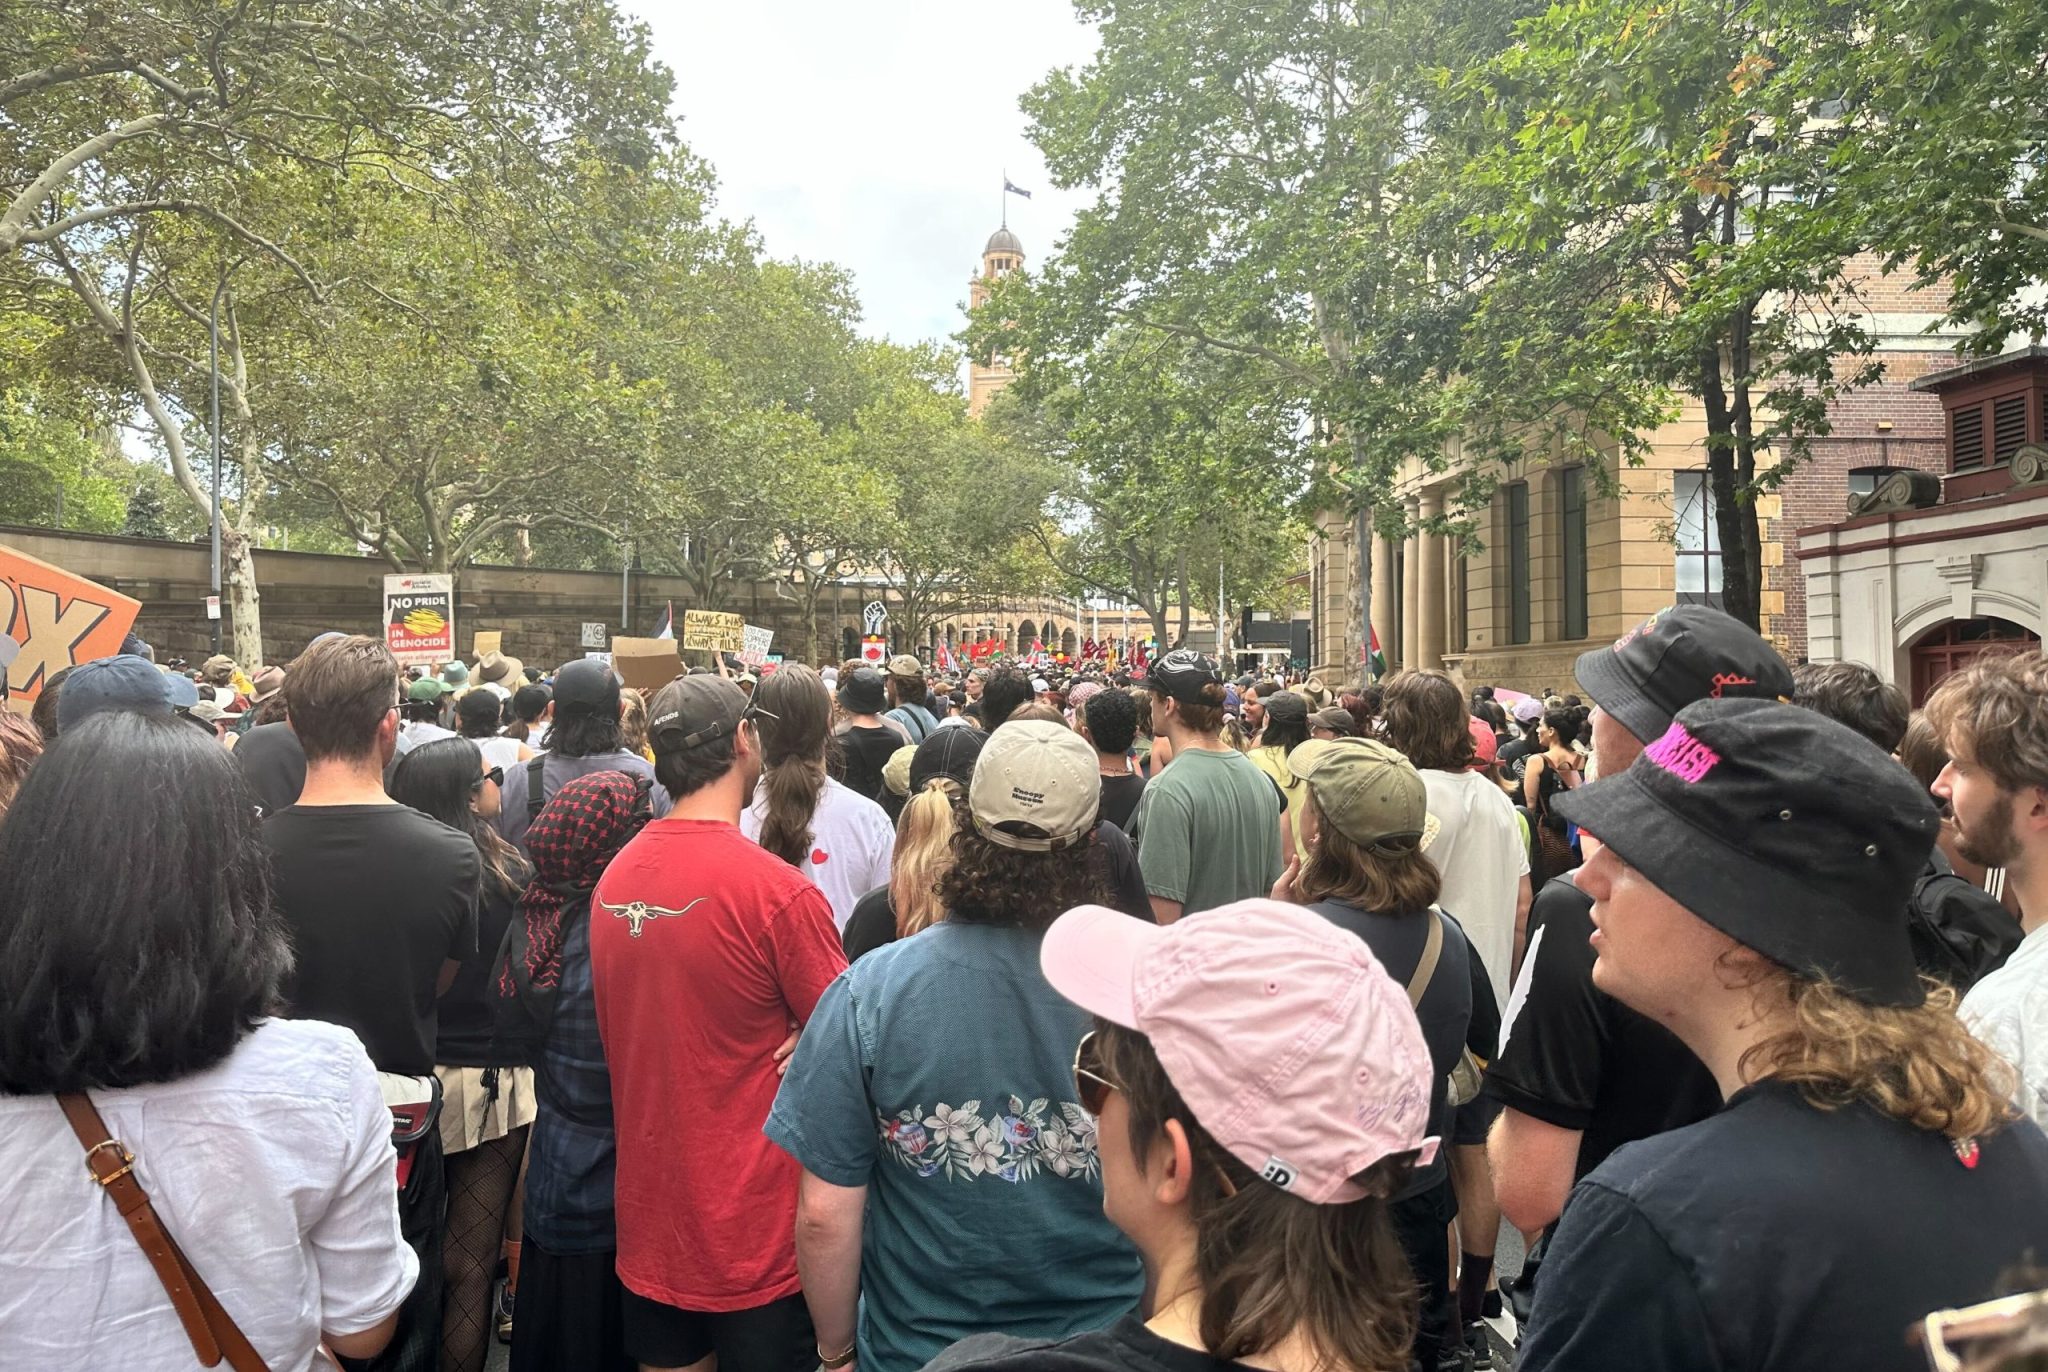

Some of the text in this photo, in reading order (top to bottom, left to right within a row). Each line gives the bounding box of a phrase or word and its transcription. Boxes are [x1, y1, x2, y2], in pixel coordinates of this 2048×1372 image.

[390, 597, 446, 608] NO PRIDE
[686, 612, 744, 628] ALWAYS WAS
[0, 578, 112, 693] X
[391, 629, 404, 638] IN
[392, 638, 446, 648] GENOCIDE
[653, 711, 679, 726] AFENDS
[1012, 793, 1043, 804] Museum
[1013, 787, 1045, 799] Snoopy
[1264, 1164, 1291, 1187] :D
